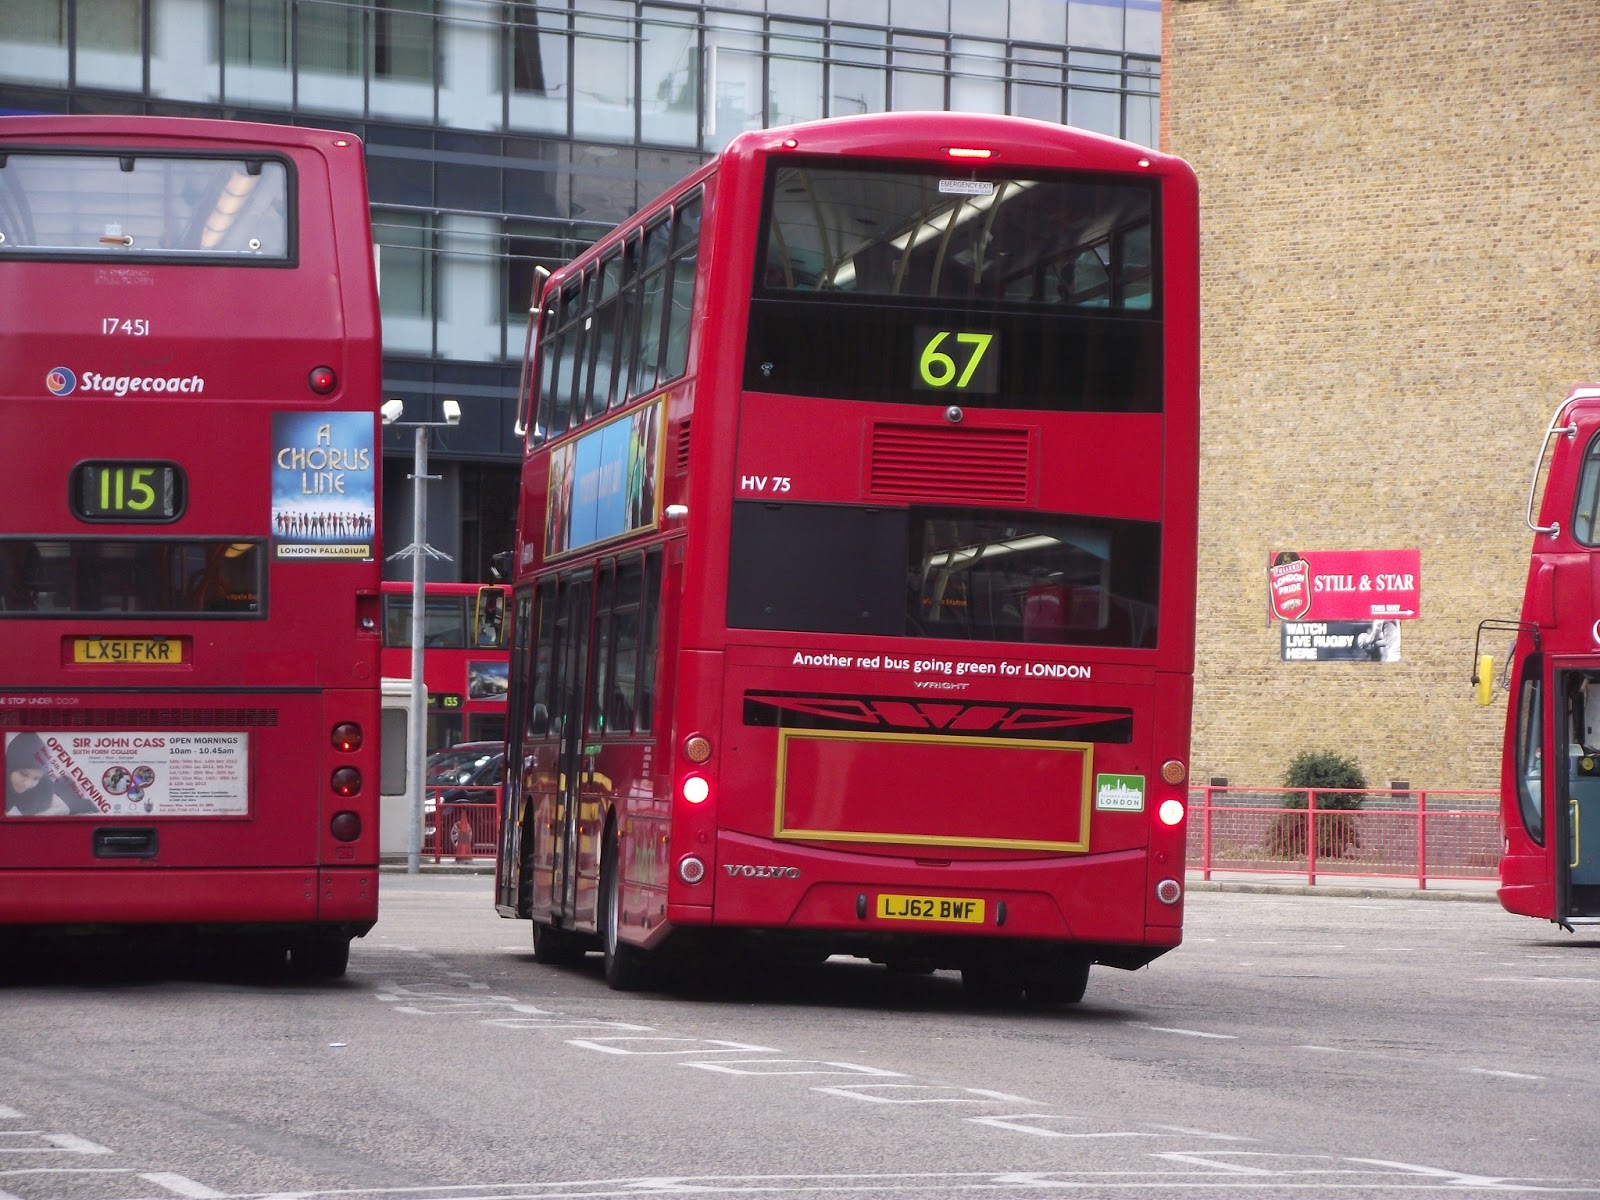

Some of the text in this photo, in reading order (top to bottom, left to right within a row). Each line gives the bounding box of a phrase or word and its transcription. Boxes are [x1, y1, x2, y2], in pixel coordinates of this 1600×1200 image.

[103, 318, 150, 336] 17451
[920, 331, 993, 388] 67
[80, 371, 205, 397] Stagecoach
[317, 423, 331, 447] A
[277, 447, 370, 471] CHORUS
[101, 468, 155, 511] 115
[302, 472, 345, 495] LINE
[741, 475, 791, 492] HV 75
[280, 547, 367, 555] LONDON PALLADIUM
[1273, 572, 1305, 589] LONDON
[1278, 582, 1302, 596] PRIDE
[1314, 574, 1415, 592] STILL & STAR
[1370, 604, 1401, 612] THIS WAY
[1286, 623, 1328, 635] WATCH
[1286, 635, 1355, 648] LIVE RUGBY
[86, 642, 170, 660] LX51 FKR
[1286, 648, 1318, 660] HERE
[793, 651, 1091, 679] Another red bus going green for LONDON
[913, 680, 970, 690] WRIGHT
[73, 737, 165, 748] SIR JOHN CASS
[46, 736, 75, 769] OPEN
[70, 765, 112, 815] EVENING
[1100, 798, 1140, 806] LONDON
[723, 864, 801, 879] VOLVO
[885, 898, 976, 920] LJ62 BWF
